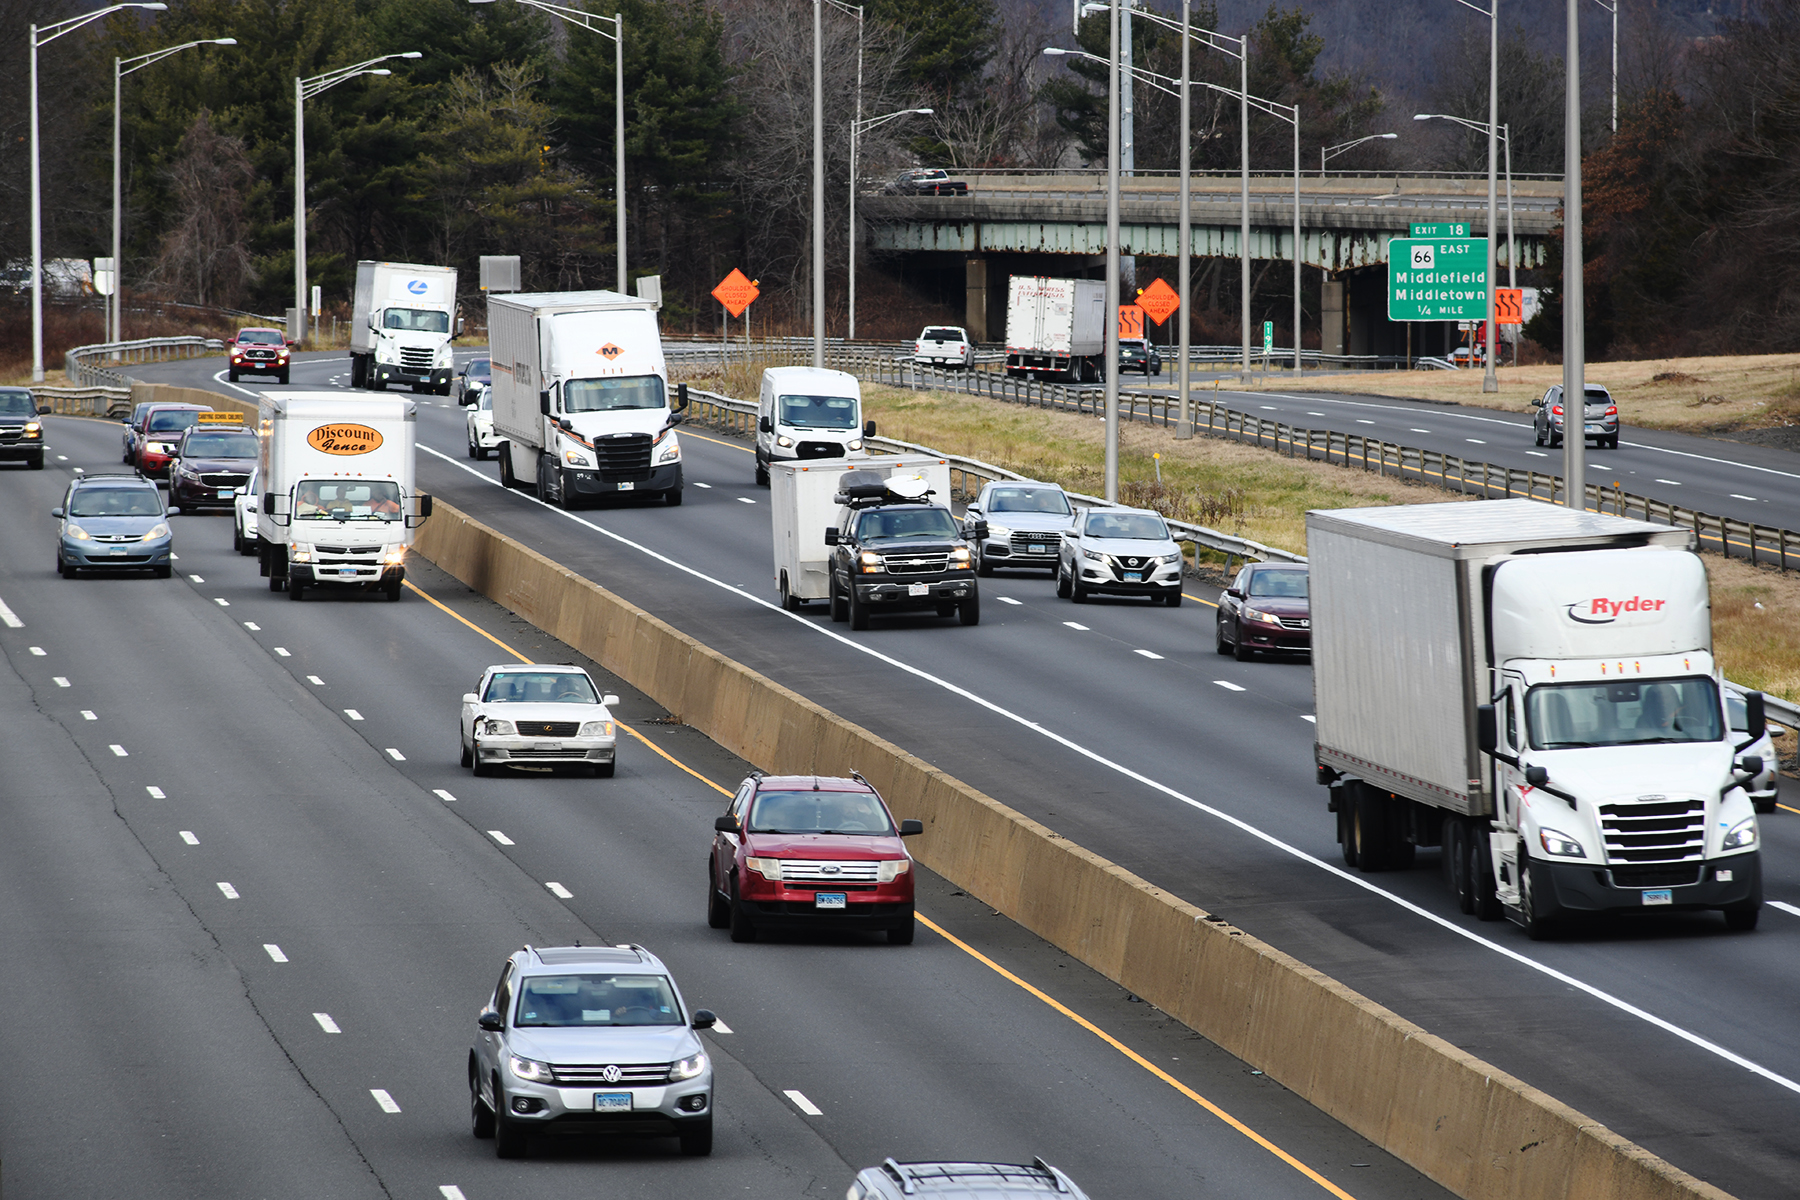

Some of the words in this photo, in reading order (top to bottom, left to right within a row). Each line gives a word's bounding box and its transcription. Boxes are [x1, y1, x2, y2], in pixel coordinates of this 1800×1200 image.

[1415, 226, 1437, 235] EXIT
[1449, 224, 1464, 236] 18
[1440, 244, 1470, 254] EAST
[1414, 251, 1432, 264] 66
[1396, 271, 1485, 284] Middlefield
[1395, 288, 1486, 301] Middletown
[1439, 305, 1464, 314] MILE
[601, 347, 619, 355] M
[227, 413, 244, 421] CHILDREN
[316, 426, 375, 443] Discount
[321, 438, 367, 451] Fence
[1591, 595, 1666, 617] Ryder
